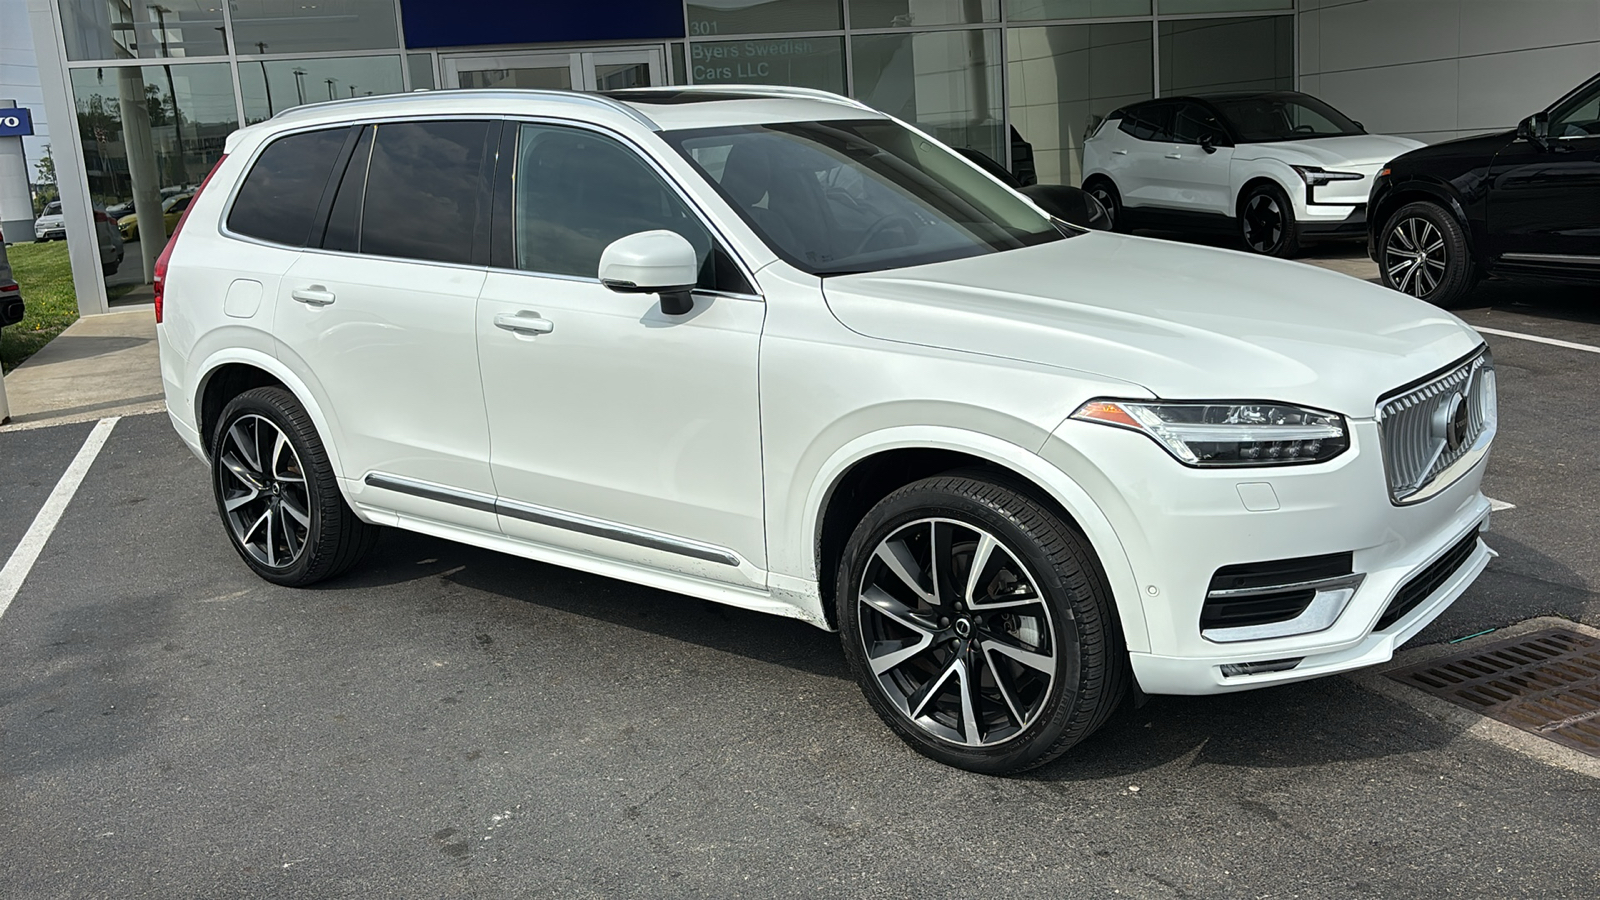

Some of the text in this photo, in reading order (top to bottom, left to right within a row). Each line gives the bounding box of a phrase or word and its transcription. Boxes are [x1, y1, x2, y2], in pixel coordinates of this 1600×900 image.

[690, 21, 718, 35] 301
[692, 40, 812, 62] Byers Swedish
[693, 62, 769, 80] Cars LLC
